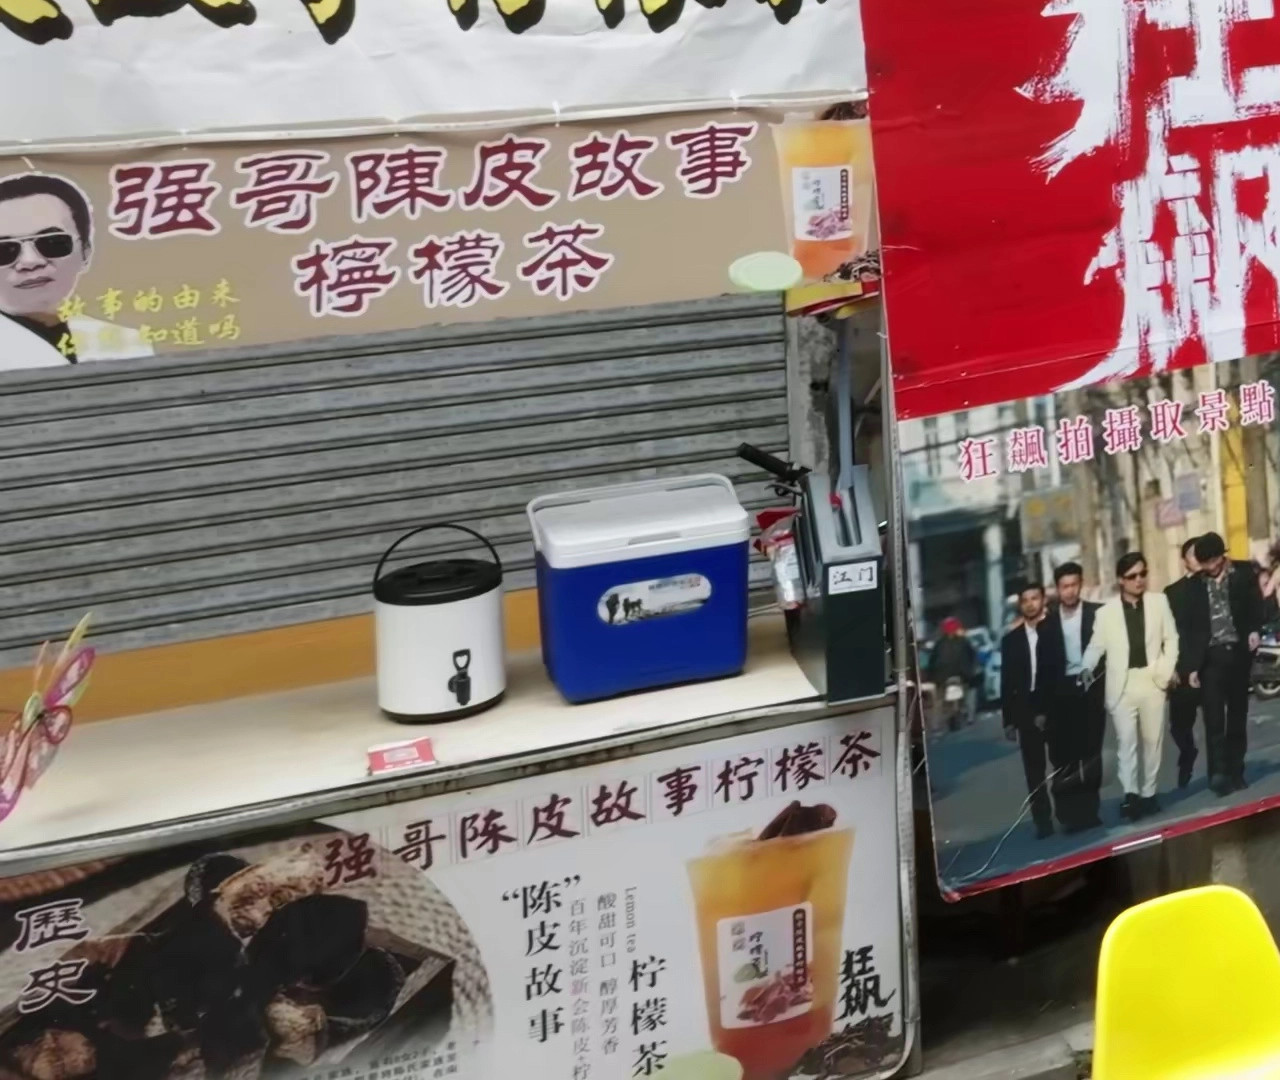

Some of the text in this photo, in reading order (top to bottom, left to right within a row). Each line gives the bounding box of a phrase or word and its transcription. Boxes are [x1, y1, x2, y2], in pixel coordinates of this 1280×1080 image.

[110, 121, 760, 242] 强哥陳皮故事
[292, 221, 613, 318] 檸檬茶
[832, 565, 876, 587] 江门
[324, 730, 882, 889] 强哥陈皮故事柠檬茶
[13, 897, 98, 1013] 歷史
[597, 891, 618, 969] 酸甜可口
[836, 943, 897, 1021] 狂飙
[627, 955, 669, 1078] 柠檬茶
